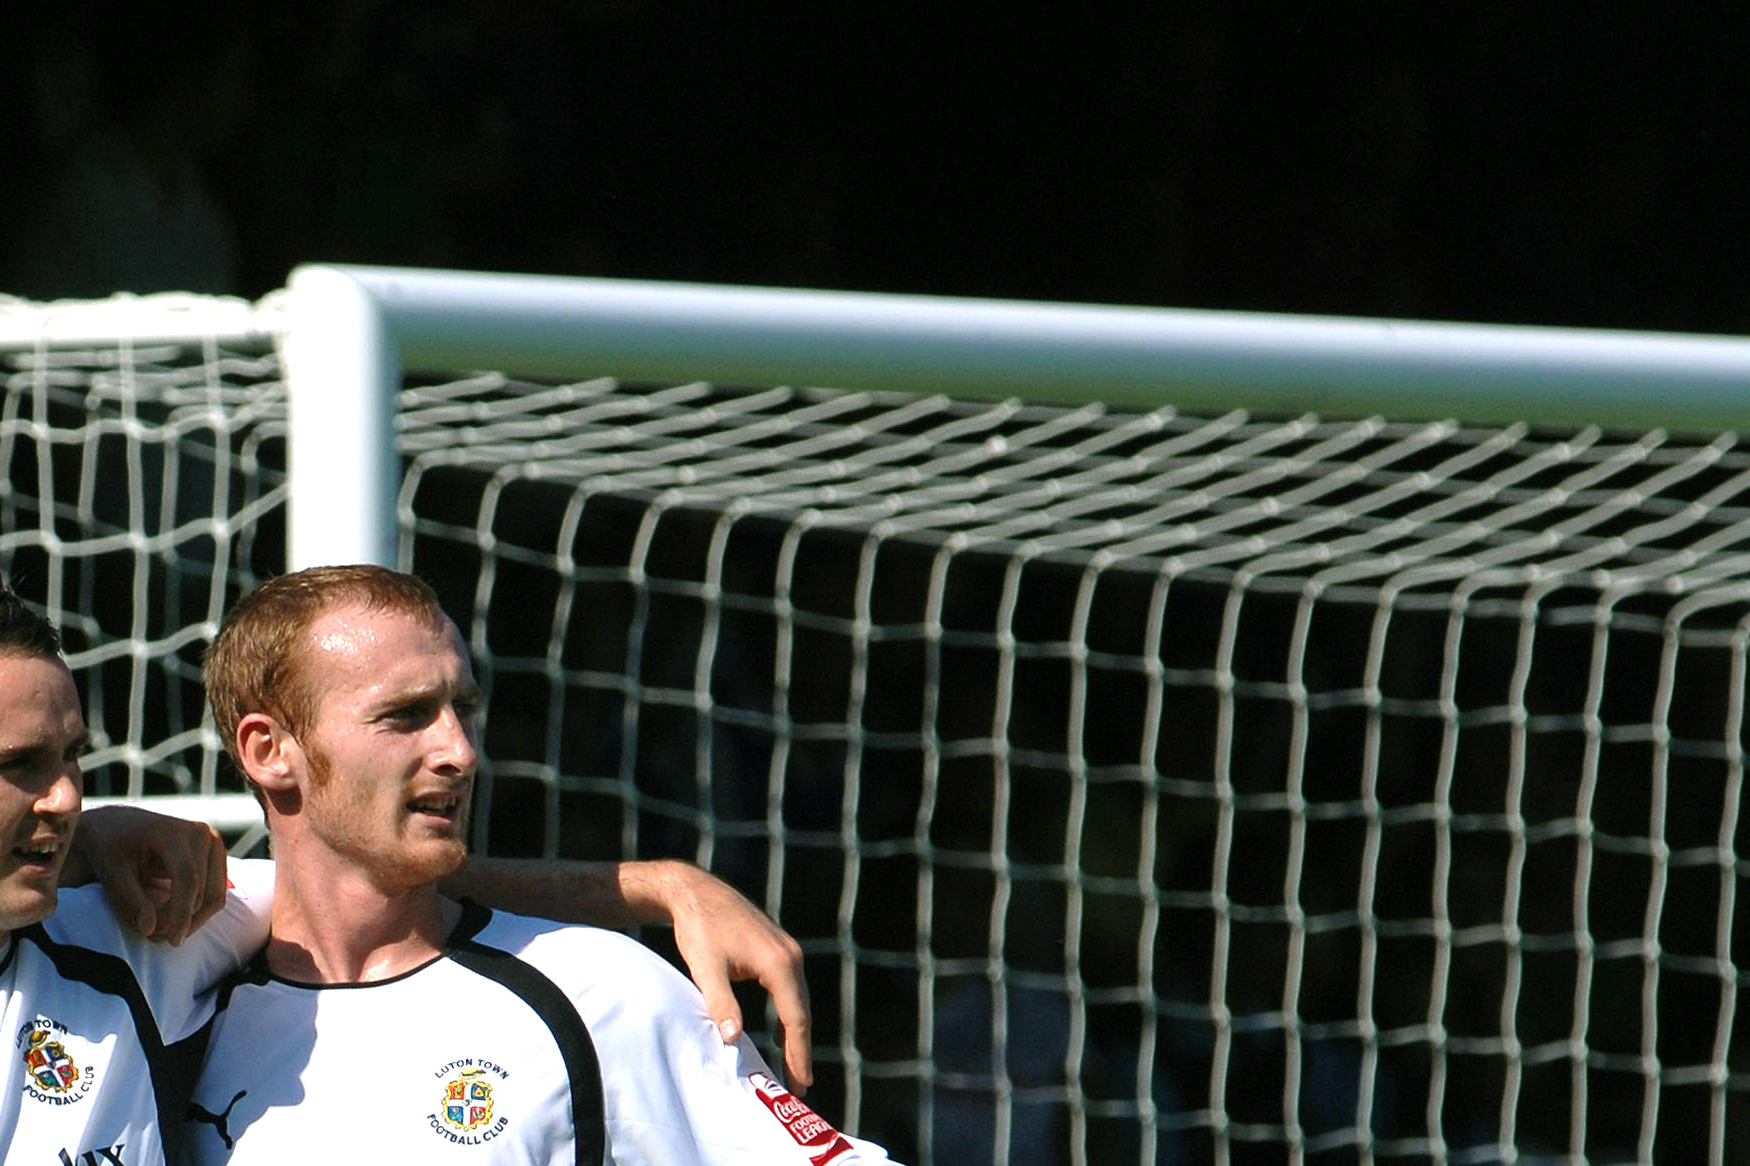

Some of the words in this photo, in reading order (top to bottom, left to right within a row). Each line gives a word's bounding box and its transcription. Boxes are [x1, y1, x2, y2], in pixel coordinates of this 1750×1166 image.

[435, 1058, 473, 1079] LUTON
[478, 1059, 509, 1080] TOWN
[22, 1085, 83, 1106] FOOTBALL
[427, 1113, 481, 1145] FOOTBALL
[483, 1116, 509, 1141] CLUB
